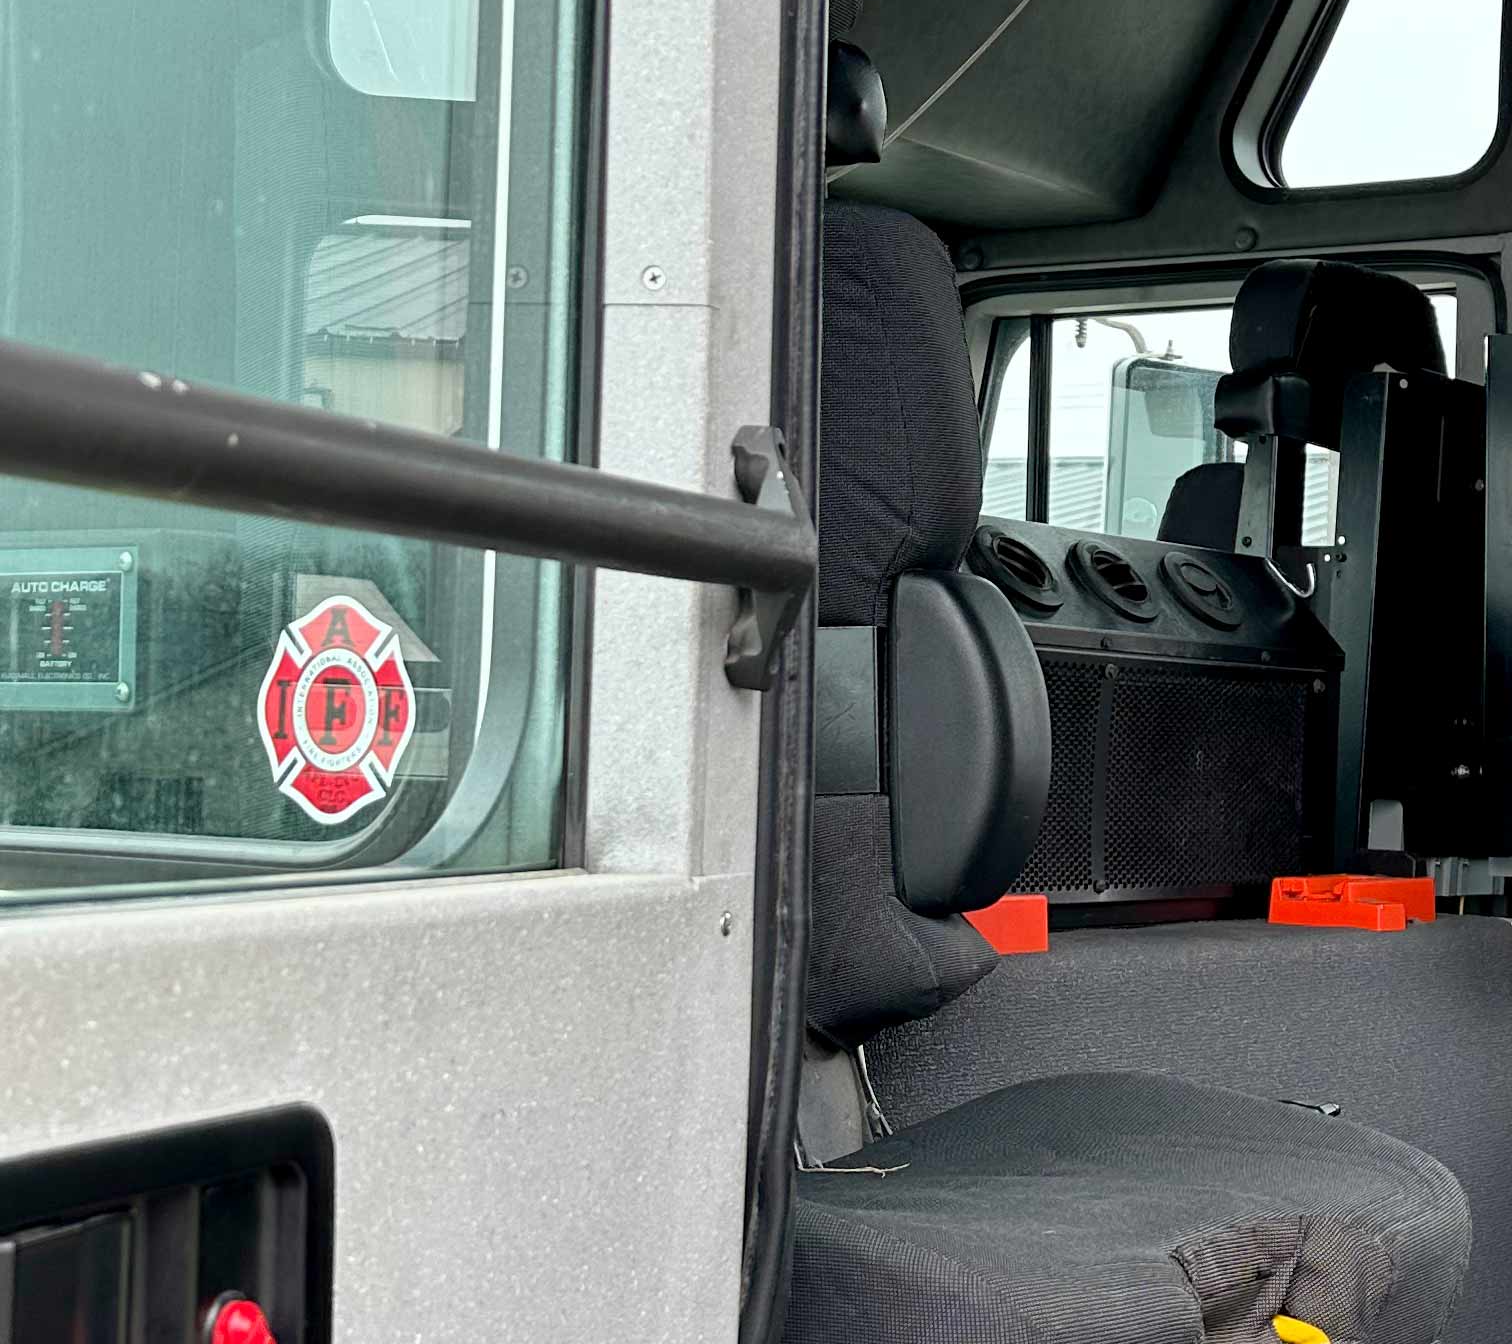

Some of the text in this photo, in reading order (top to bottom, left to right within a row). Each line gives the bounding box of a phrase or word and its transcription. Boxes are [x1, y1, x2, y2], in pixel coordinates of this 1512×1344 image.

[11, 580, 107, 593] AUTO CHARGE
[322, 608, 354, 647] A
[273, 677, 405, 746] I F F
